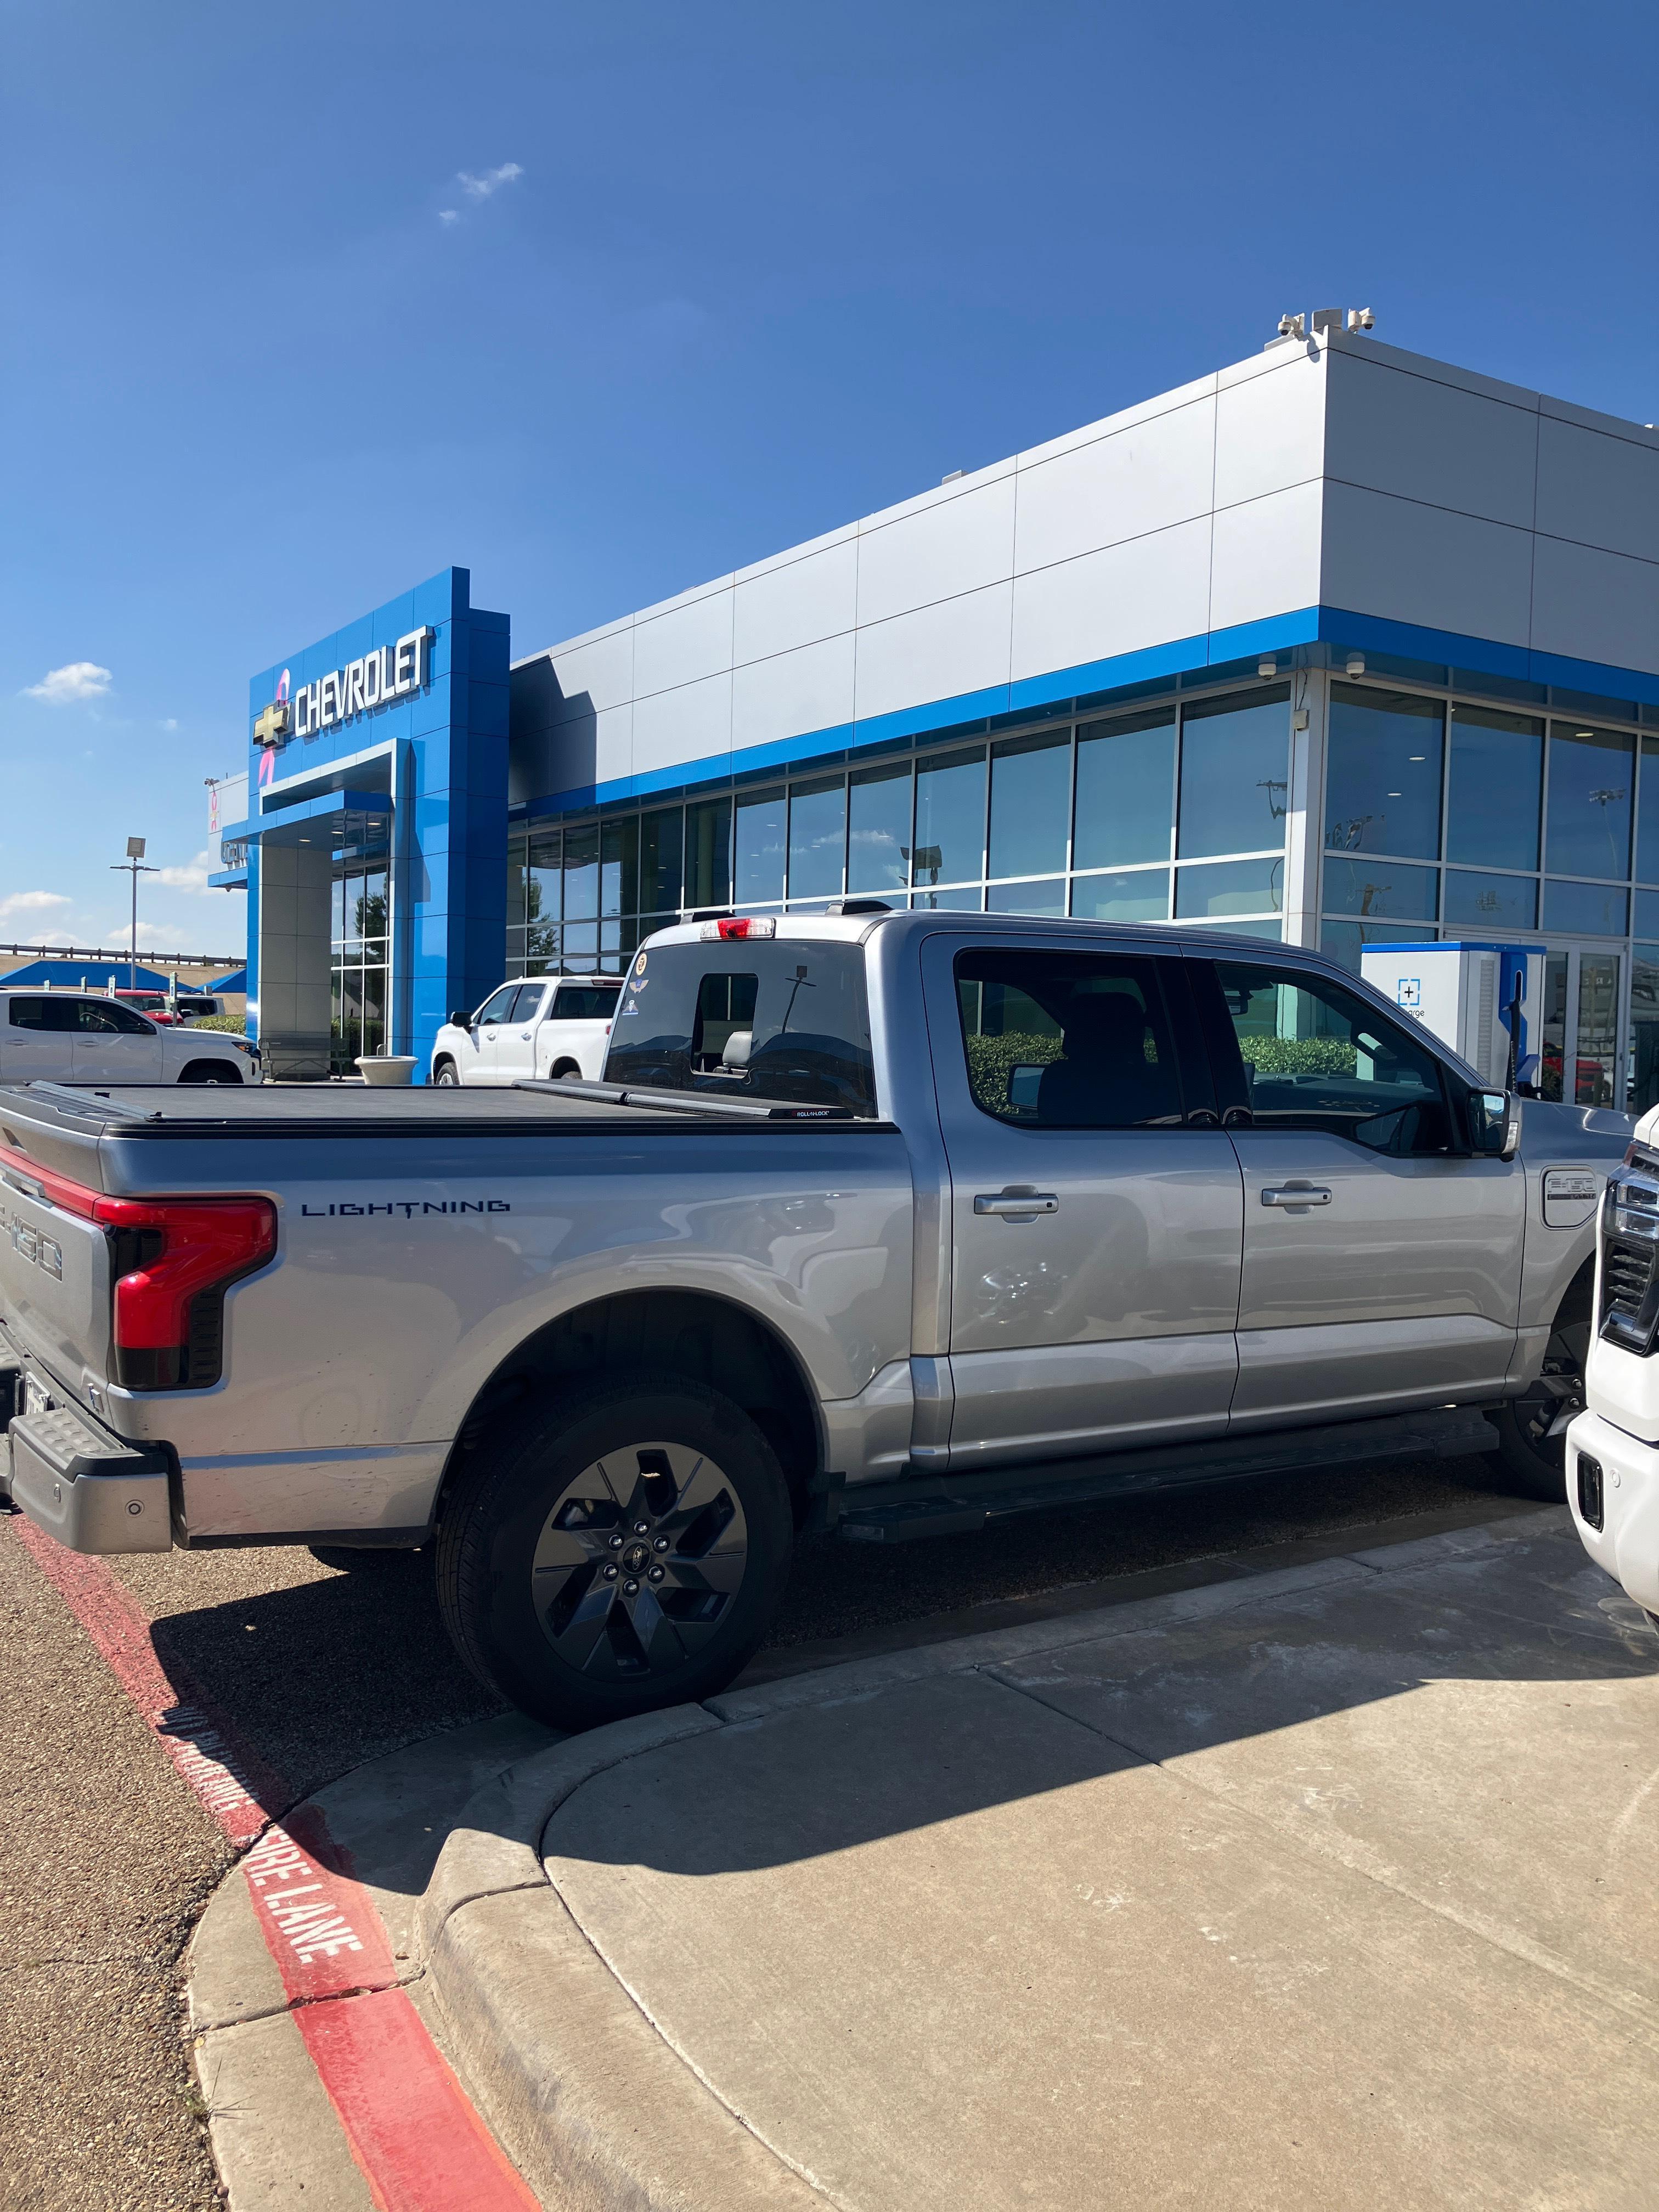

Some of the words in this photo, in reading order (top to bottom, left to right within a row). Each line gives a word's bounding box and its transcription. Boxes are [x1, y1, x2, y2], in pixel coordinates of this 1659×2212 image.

[295, 625, 433, 737] CHEVROLET
[1408, 1009, 1425, 1019] arge
[302, 1200, 510, 1218] LIGHTNING
[241, 1827, 313, 1887] FIRE
[263, 1883, 364, 1964] LANE
